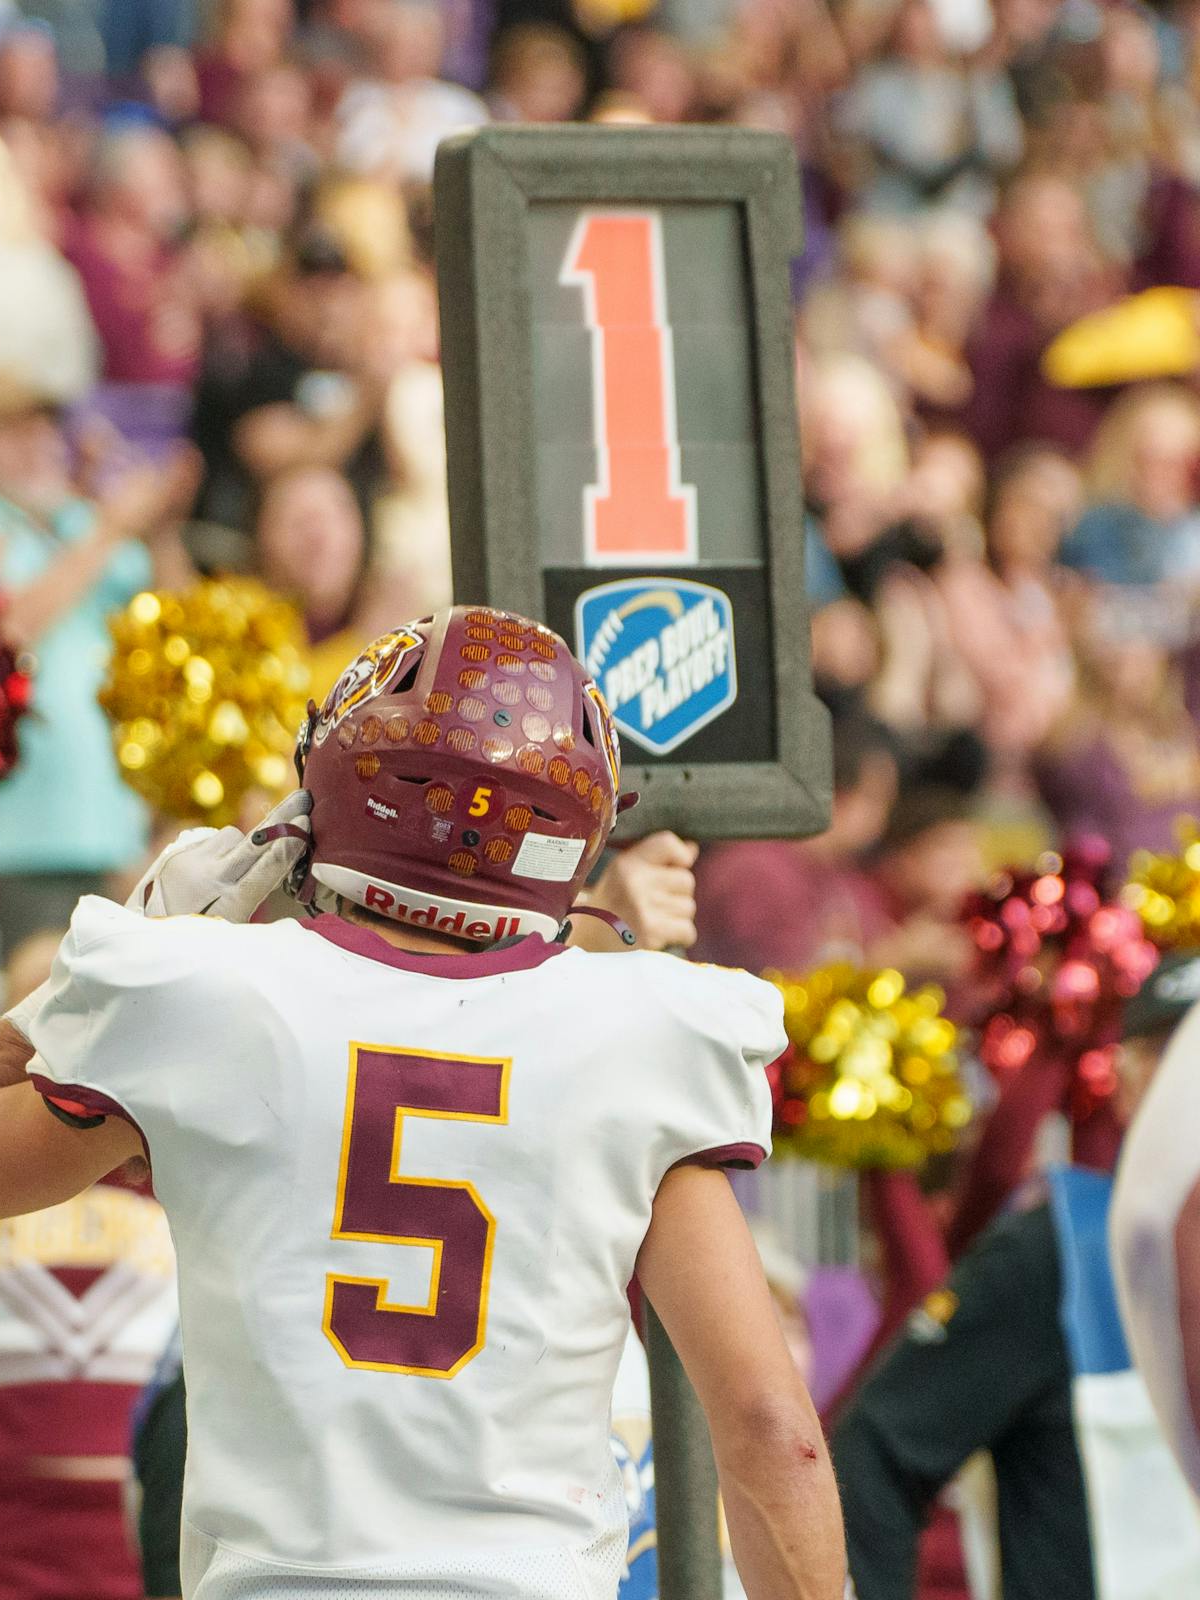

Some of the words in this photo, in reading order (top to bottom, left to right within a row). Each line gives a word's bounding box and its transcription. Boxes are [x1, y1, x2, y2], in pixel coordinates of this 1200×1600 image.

[560, 210, 698, 566] 1
[467, 626, 496, 640] PRIDE
[498, 634, 526, 650] PRIDE
[461, 644, 491, 661] PRIDE
[531, 641, 557, 660] PRIDE
[606, 637, 660, 714] PREP
[660, 593, 721, 672] BOWL
[460, 670, 488, 689] PRIDE
[641, 627, 727, 730] PLAYOFF
[426, 692, 453, 715] PRIDE
[457, 697, 487, 723] PRIDE
[413, 721, 441, 745] PRIDE
[446, 729, 476, 753] PRIDE
[549, 759, 571, 786] PRIDE
[367, 797, 398, 818] Riddell
[426, 787, 455, 812] PRIDE
[468, 787, 492, 817] 5
[505, 807, 532, 832] PRIDE
[484, 839, 513, 862] PRIDE
[448, 852, 477, 877] PRIDE
[364, 883, 521, 941] Riddell
[320, 1041, 512, 1378] 5
